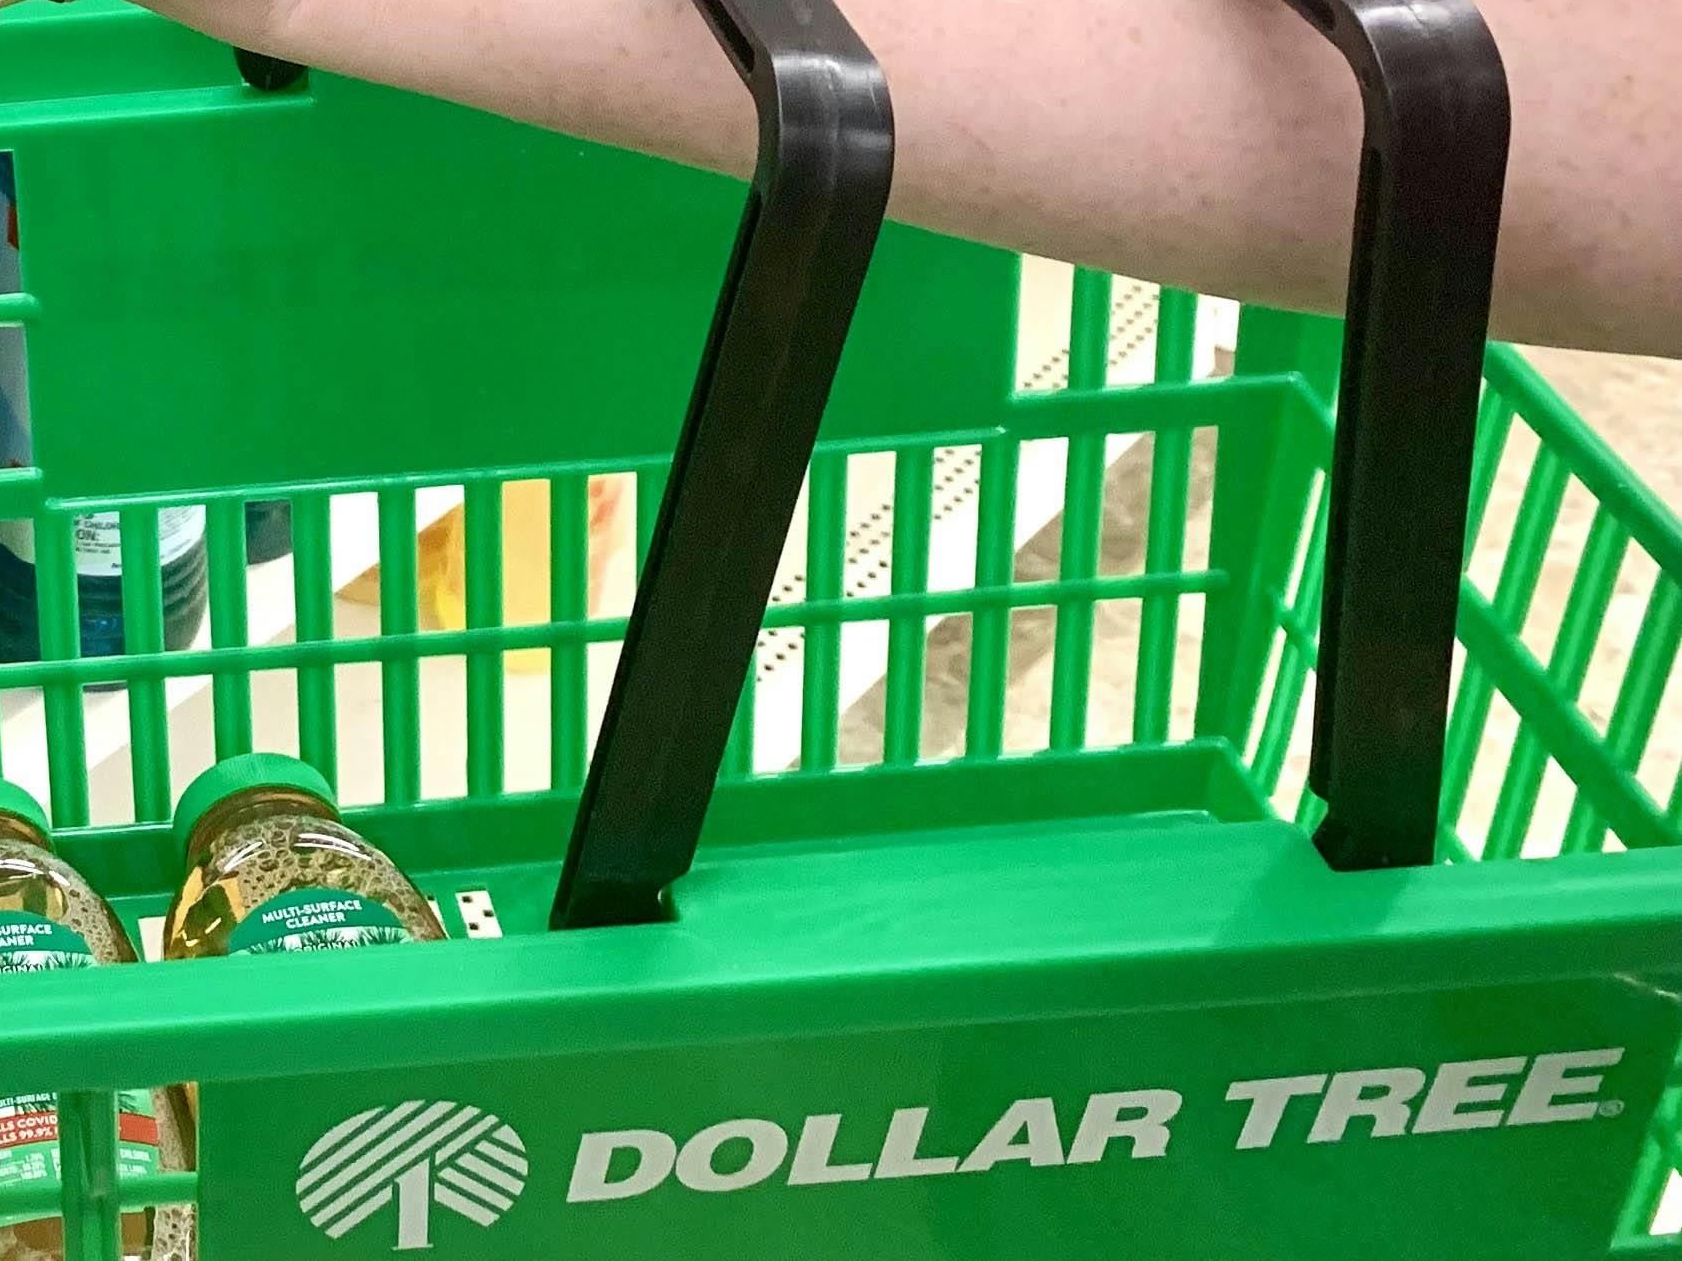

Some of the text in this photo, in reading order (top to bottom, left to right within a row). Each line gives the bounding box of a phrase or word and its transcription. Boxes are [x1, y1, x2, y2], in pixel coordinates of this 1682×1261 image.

[262, 898, 363, 925] MULTI-SURFACE
[285, 911, 347, 930] CLEANER
[565, 1046, 1626, 1204] DOLLAR TREE
